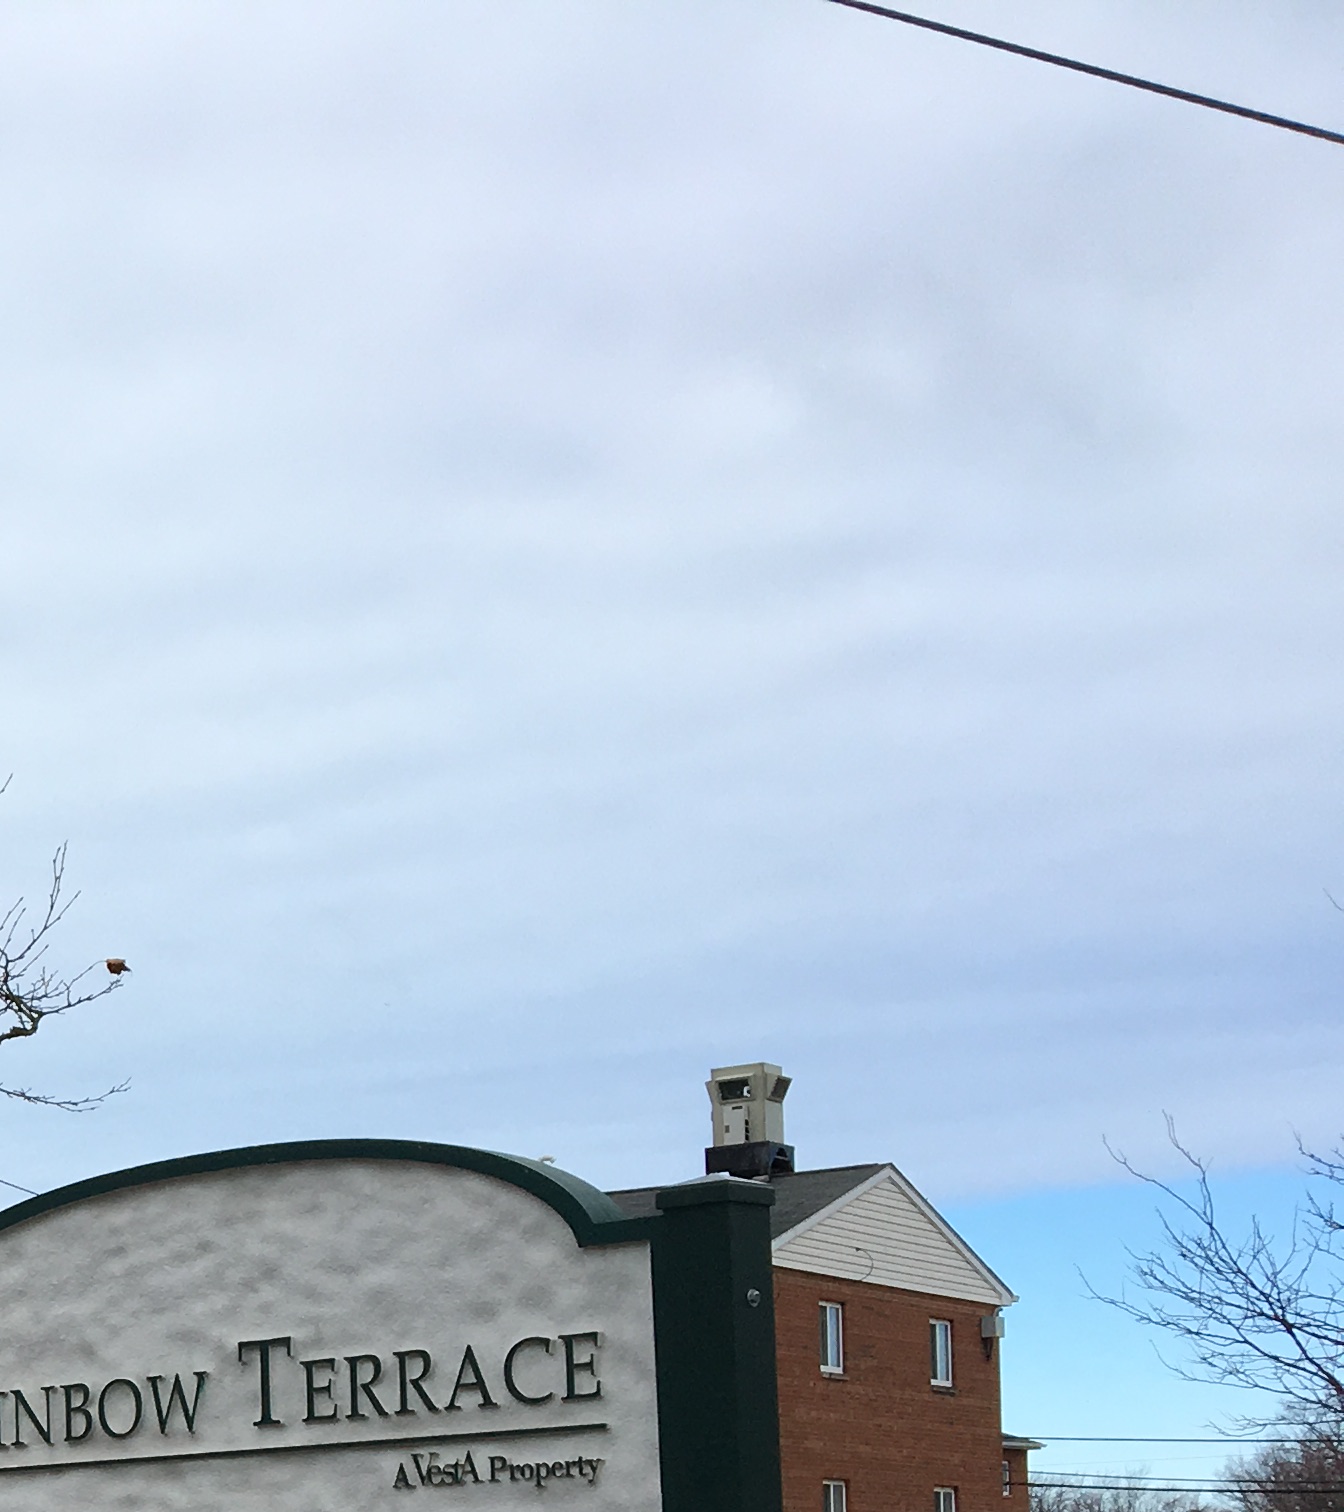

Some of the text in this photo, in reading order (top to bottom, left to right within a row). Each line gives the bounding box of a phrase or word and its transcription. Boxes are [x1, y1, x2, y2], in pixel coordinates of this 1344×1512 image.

[237, 1331, 603, 1428] TERRACE
[393, 1462, 416, 1489] A
[488, 1455, 605, 1488] Property
